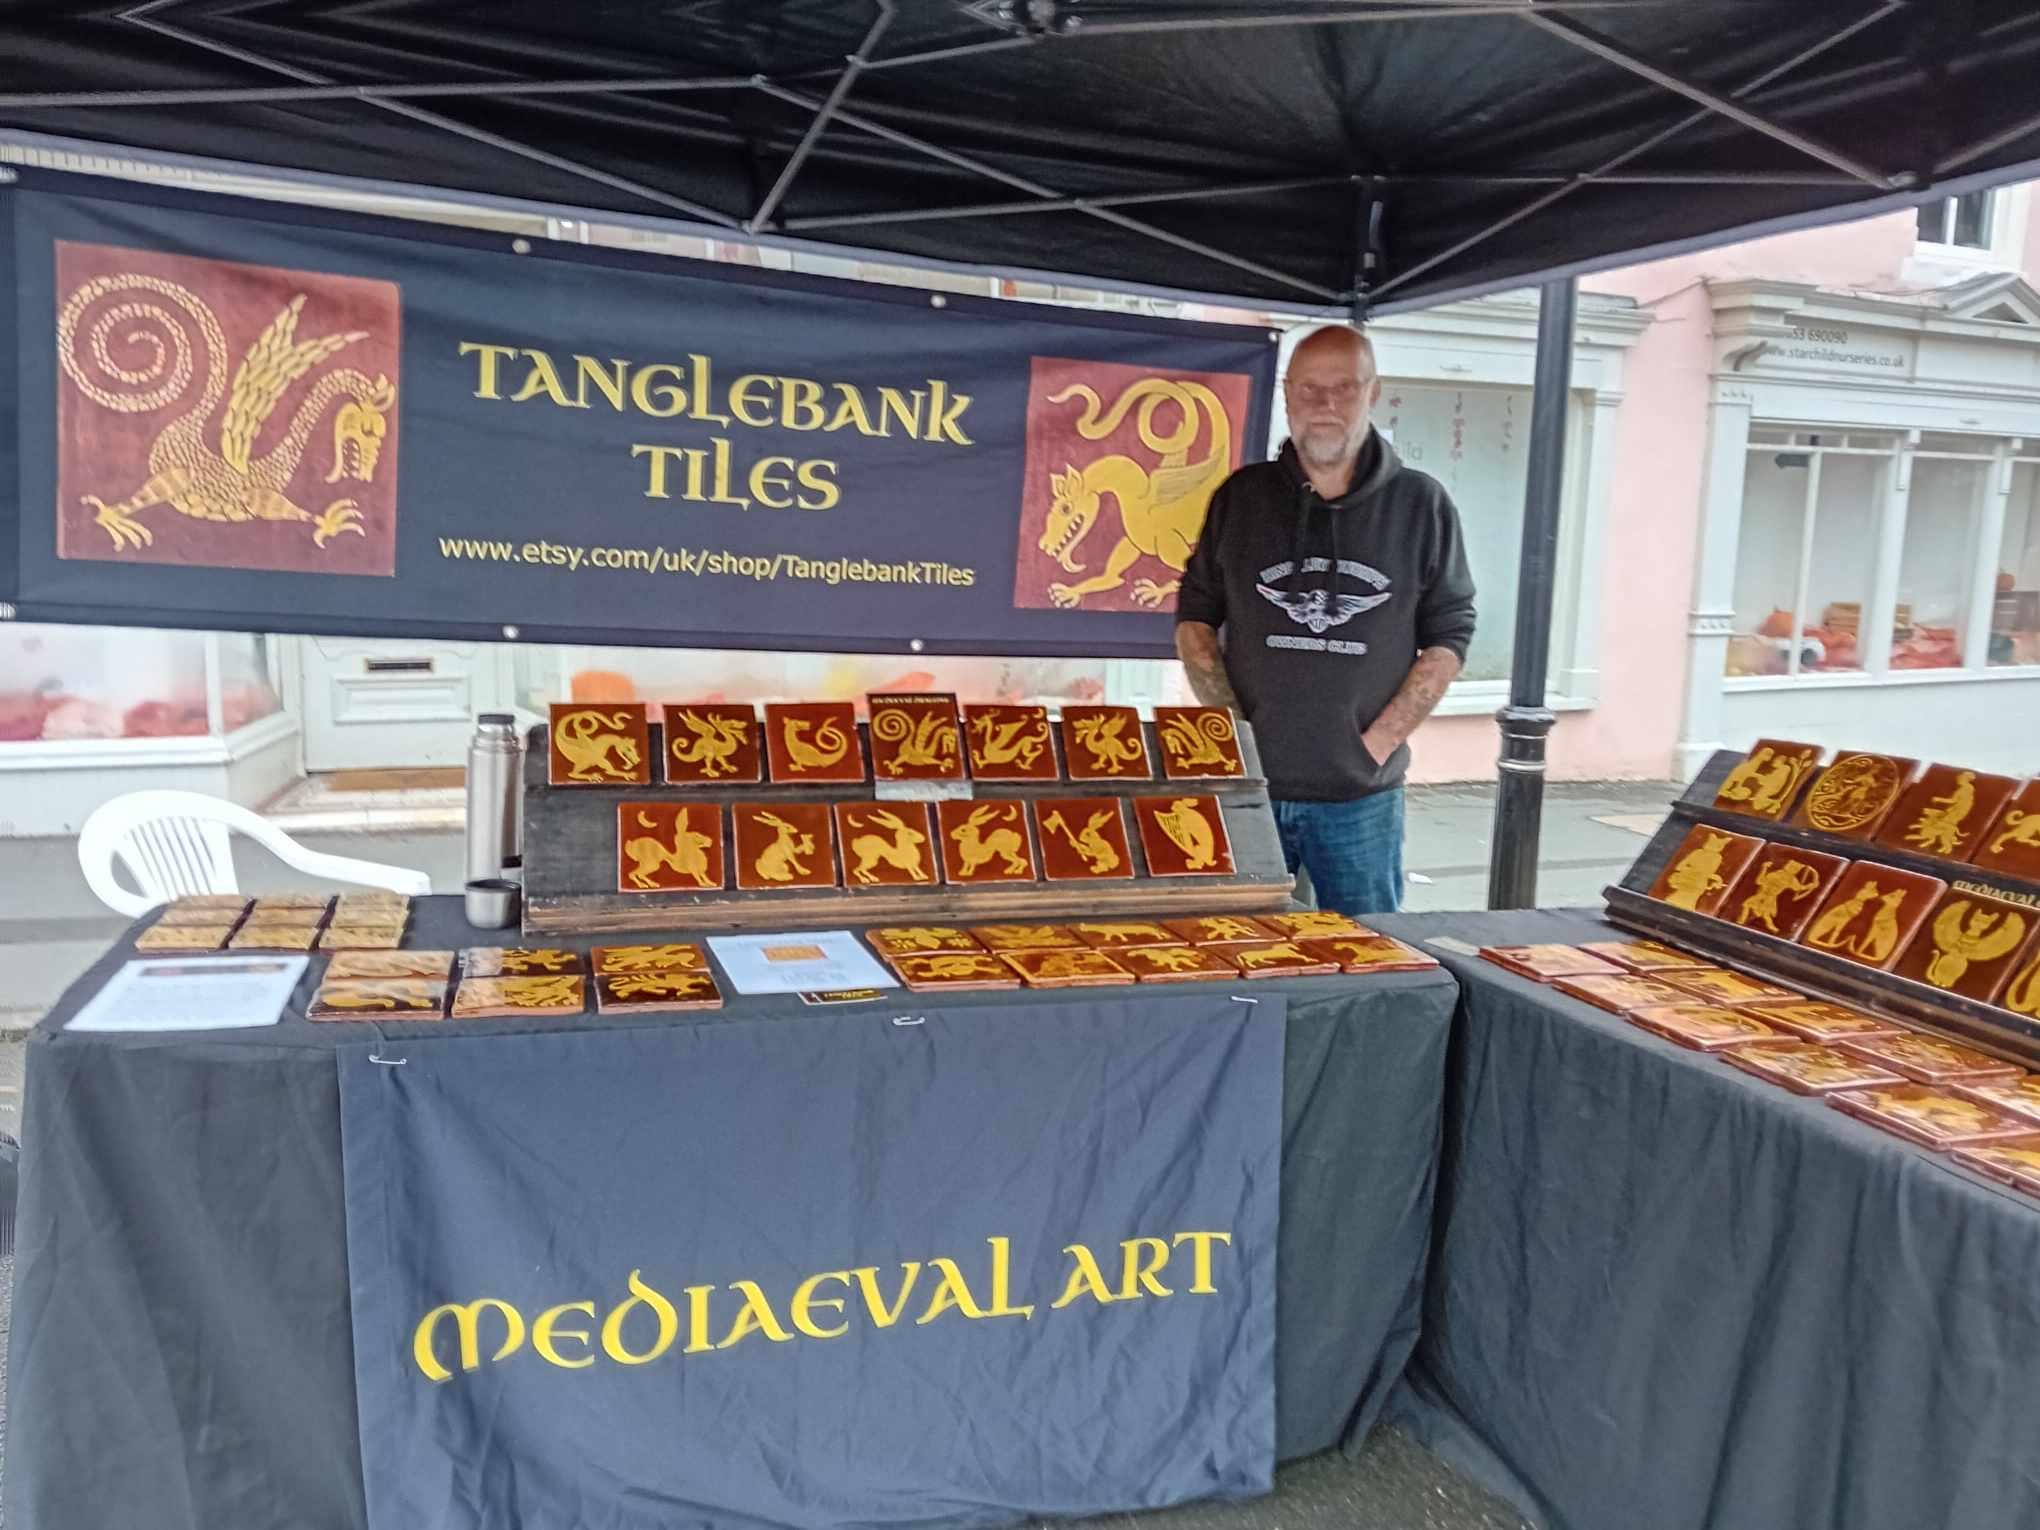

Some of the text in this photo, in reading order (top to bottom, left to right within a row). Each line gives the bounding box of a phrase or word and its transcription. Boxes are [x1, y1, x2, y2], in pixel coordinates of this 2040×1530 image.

[458, 341, 976, 446] TANGLEBANK
[631, 436, 842, 512] TILES
[438, 536, 976, 588] www.etsy.com/uk/shop/TanglebankTiles
[412, 1231, 1232, 1384] MEDIAEVAL ART
